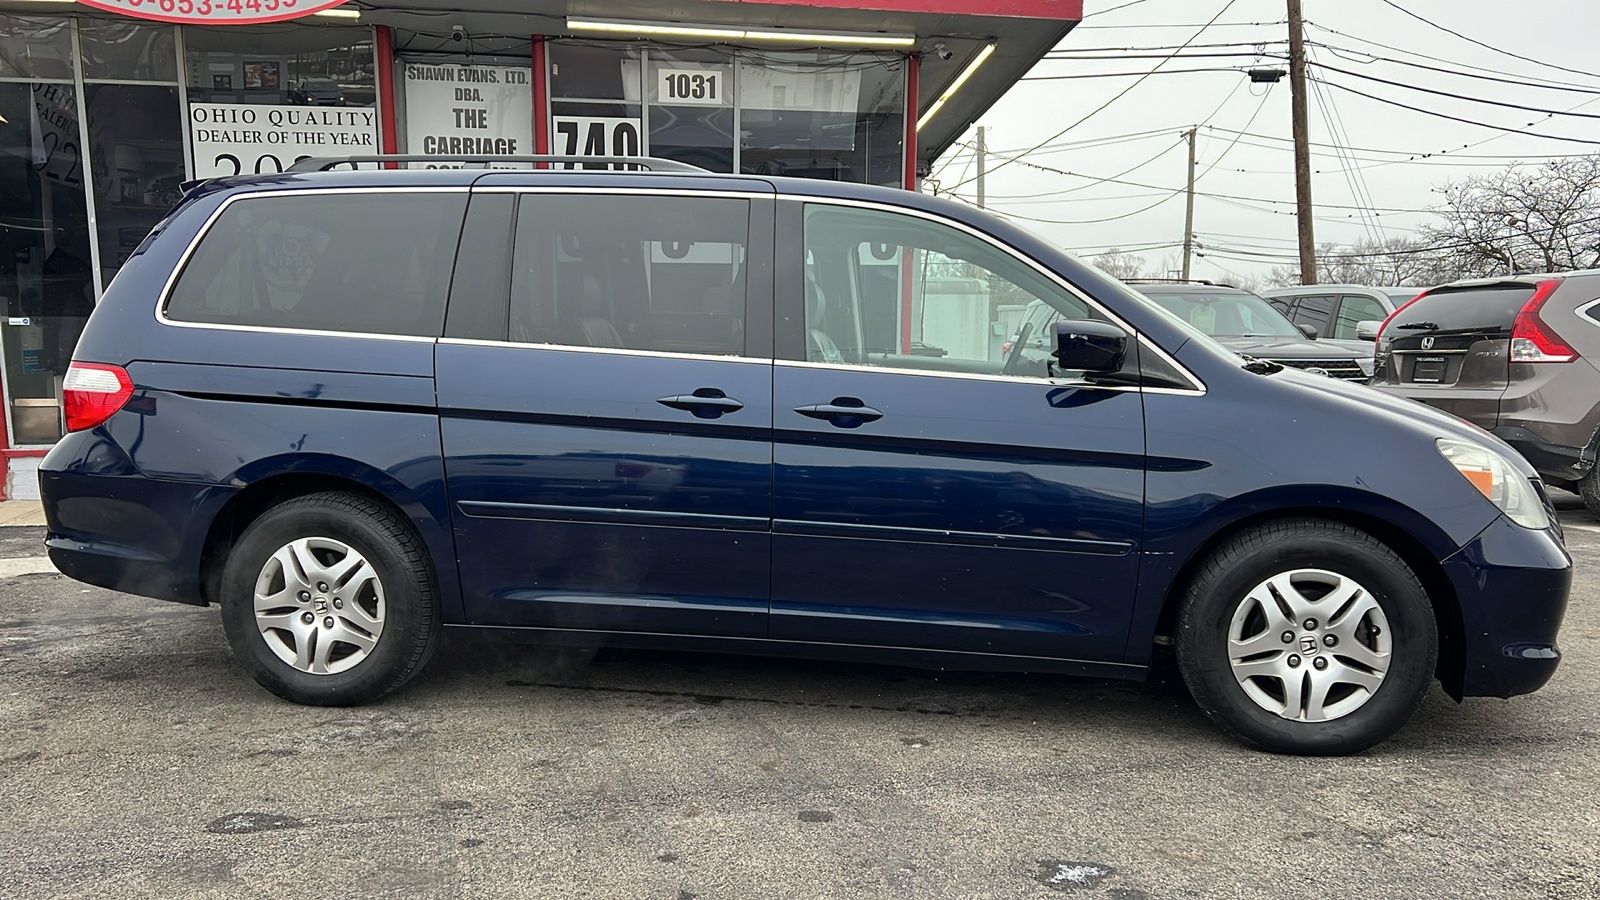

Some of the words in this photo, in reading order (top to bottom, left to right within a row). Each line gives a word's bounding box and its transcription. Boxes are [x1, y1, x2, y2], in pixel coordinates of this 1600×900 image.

[407, 66, 454, 82] SHAWN
[457, 68, 500, 84] EVANS.
[505, 71, 529, 85] LTD.
[454, 87, 484, 102] DBA.
[665, 73, 717, 99] 1031
[193, 107, 257, 124] OHIO
[268, 109, 374, 128] QUALITY
[452, 107, 488, 129] THE
[197, 129, 263, 143] DEALER
[266, 131, 290, 144] OF
[292, 132, 326, 145] THE
[329, 133, 373, 146] YEAR
